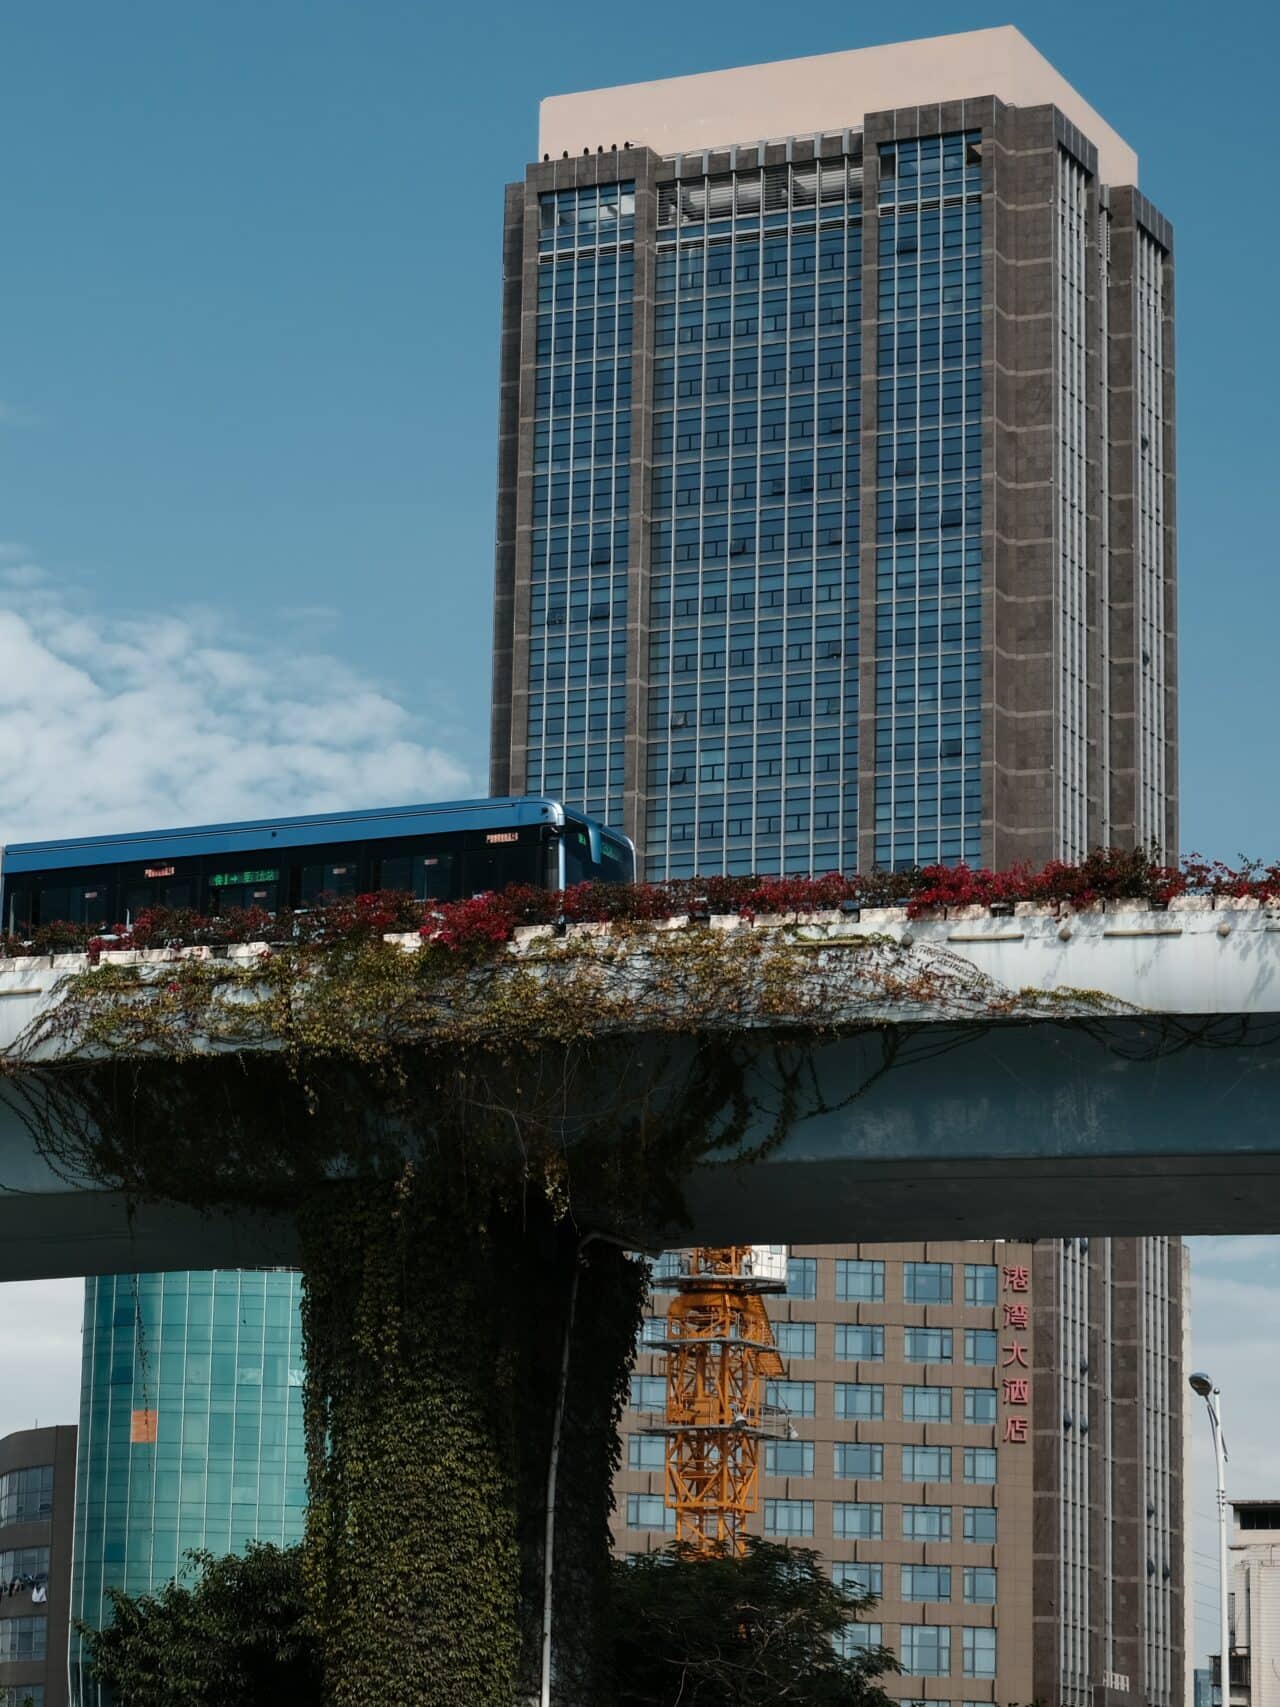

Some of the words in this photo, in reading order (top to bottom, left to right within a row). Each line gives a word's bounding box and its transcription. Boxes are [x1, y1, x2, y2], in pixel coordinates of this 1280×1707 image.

[1002, 1265, 1029, 1443] 港湾大酒店
